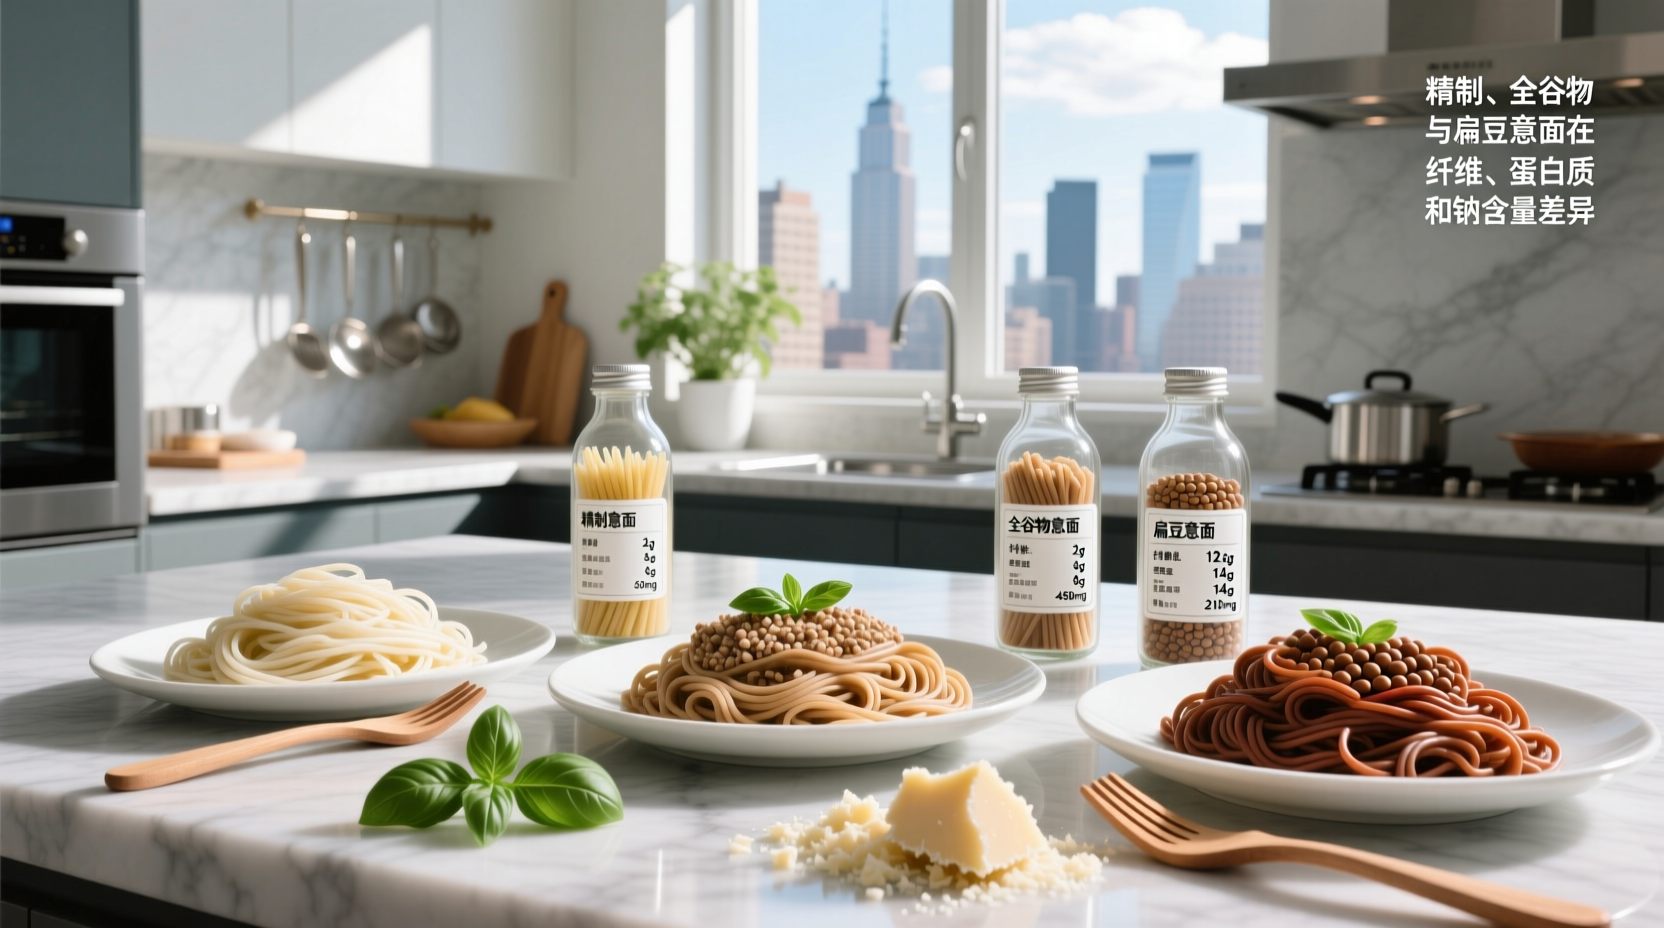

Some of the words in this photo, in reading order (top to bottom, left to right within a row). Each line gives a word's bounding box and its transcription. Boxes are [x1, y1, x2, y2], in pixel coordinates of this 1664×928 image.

[1008, 516, 1080, 534] 全谷物意面
[1153, 519, 1215, 539] 扁豆意面
[1072, 544, 1086, 558] 2g
[1213, 567, 1234, 581] 14g
[1213, 583, 1234, 597] 14g
